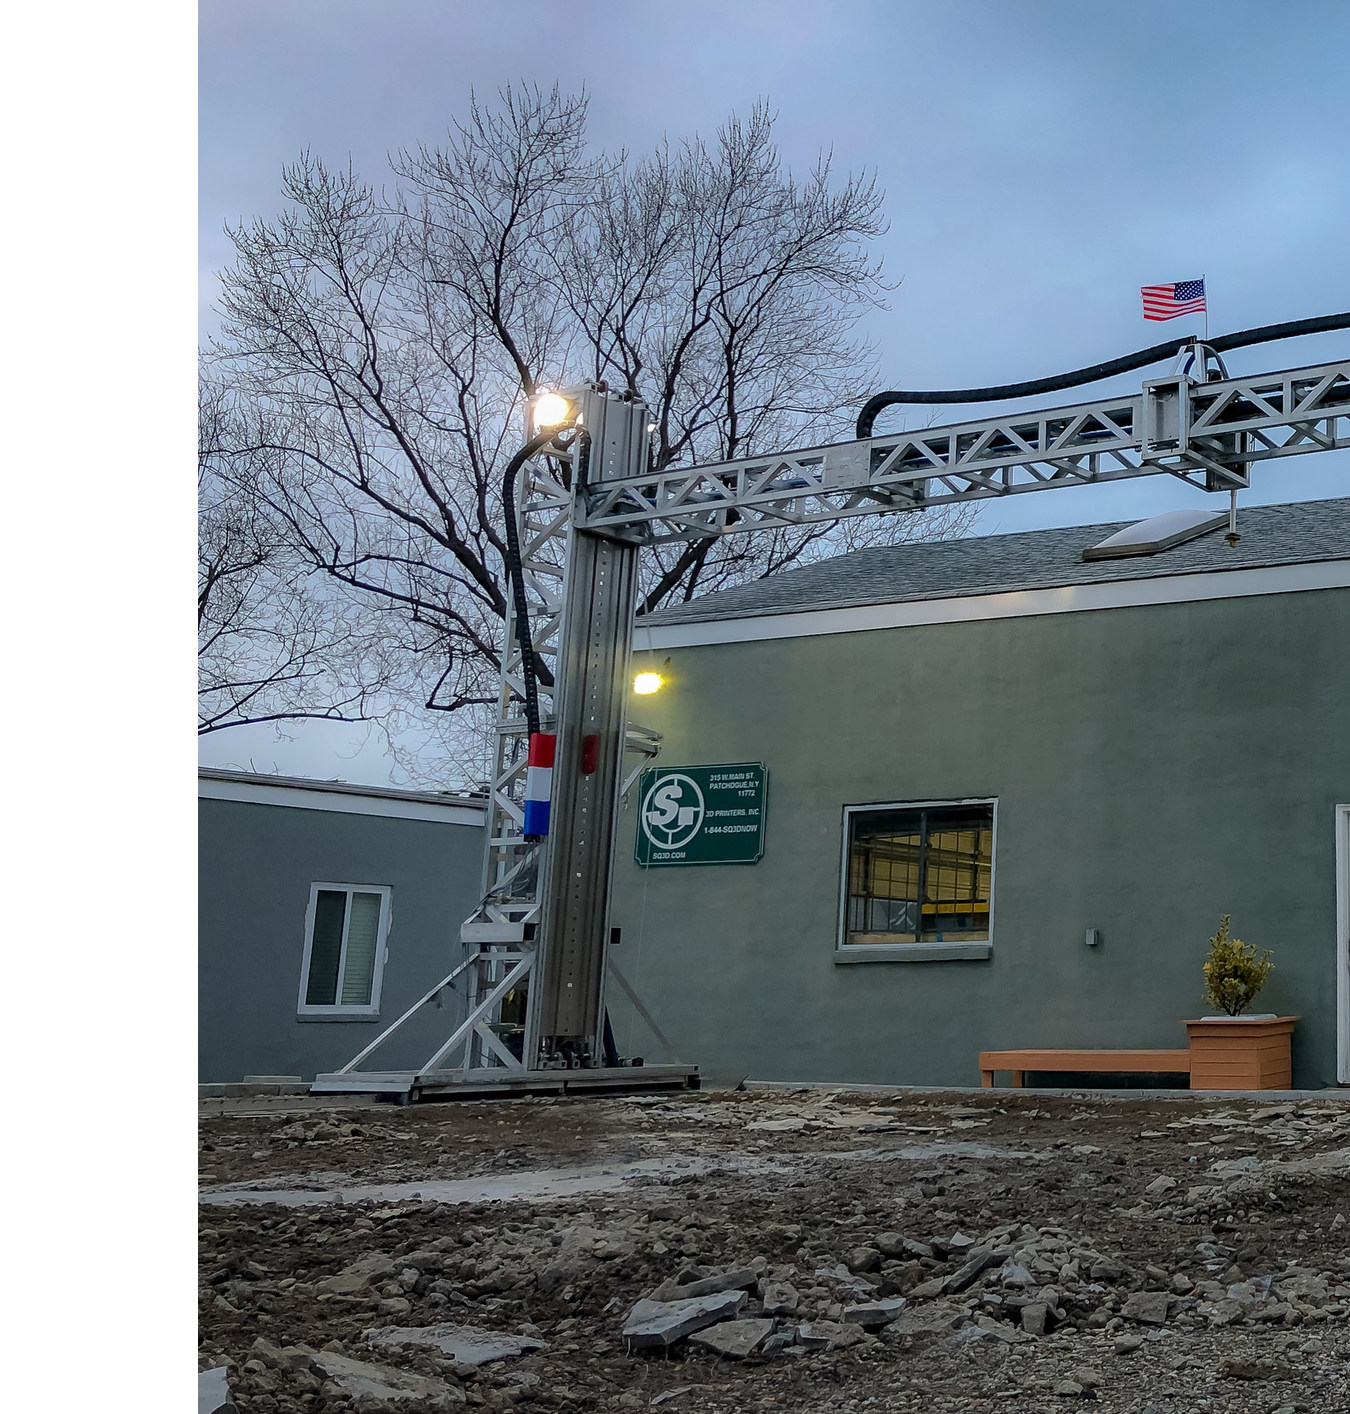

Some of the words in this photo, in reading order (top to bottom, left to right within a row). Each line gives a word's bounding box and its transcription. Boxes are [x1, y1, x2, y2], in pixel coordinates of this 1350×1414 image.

[738, 789, 756, 797] 11772
[705, 810, 714, 818] 3D
[652, 851, 687, 860] SQ3D.COM
